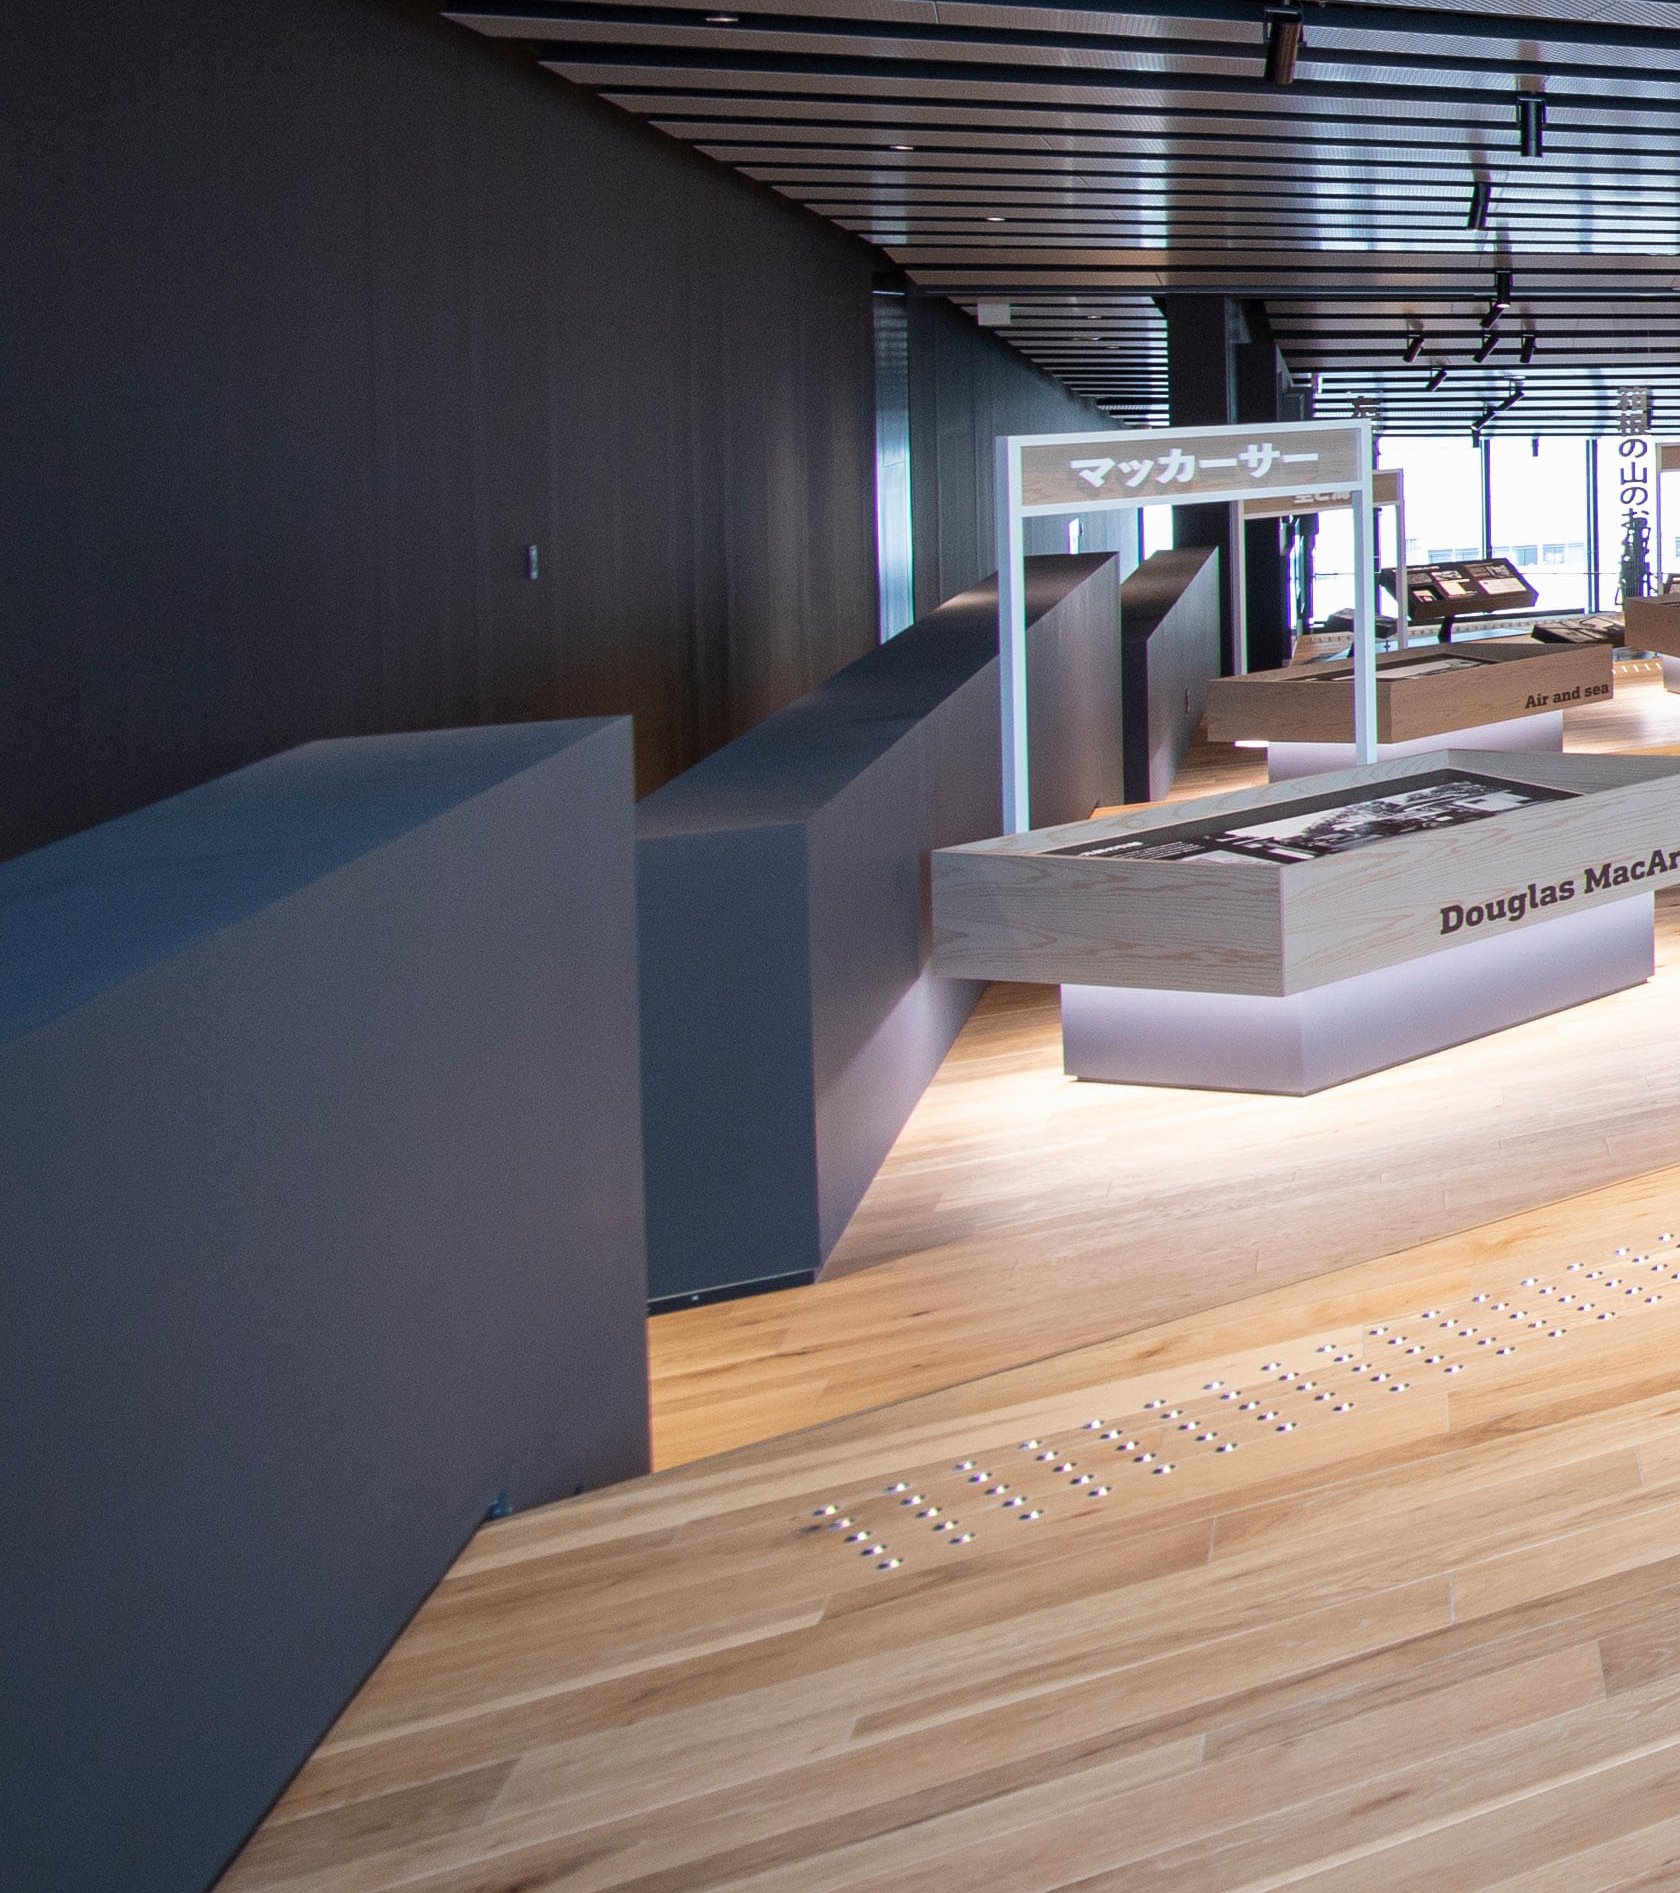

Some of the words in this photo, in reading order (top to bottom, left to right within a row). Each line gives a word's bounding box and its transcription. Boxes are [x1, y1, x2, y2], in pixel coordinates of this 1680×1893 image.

[1070, 442, 1319, 488] マッカーサー
[1524, 693, 1548, 709] Air
[1552, 686, 1581, 704] and
[1584, 683, 1609, 698] sea
[1440, 878, 1575, 935] Douglas
